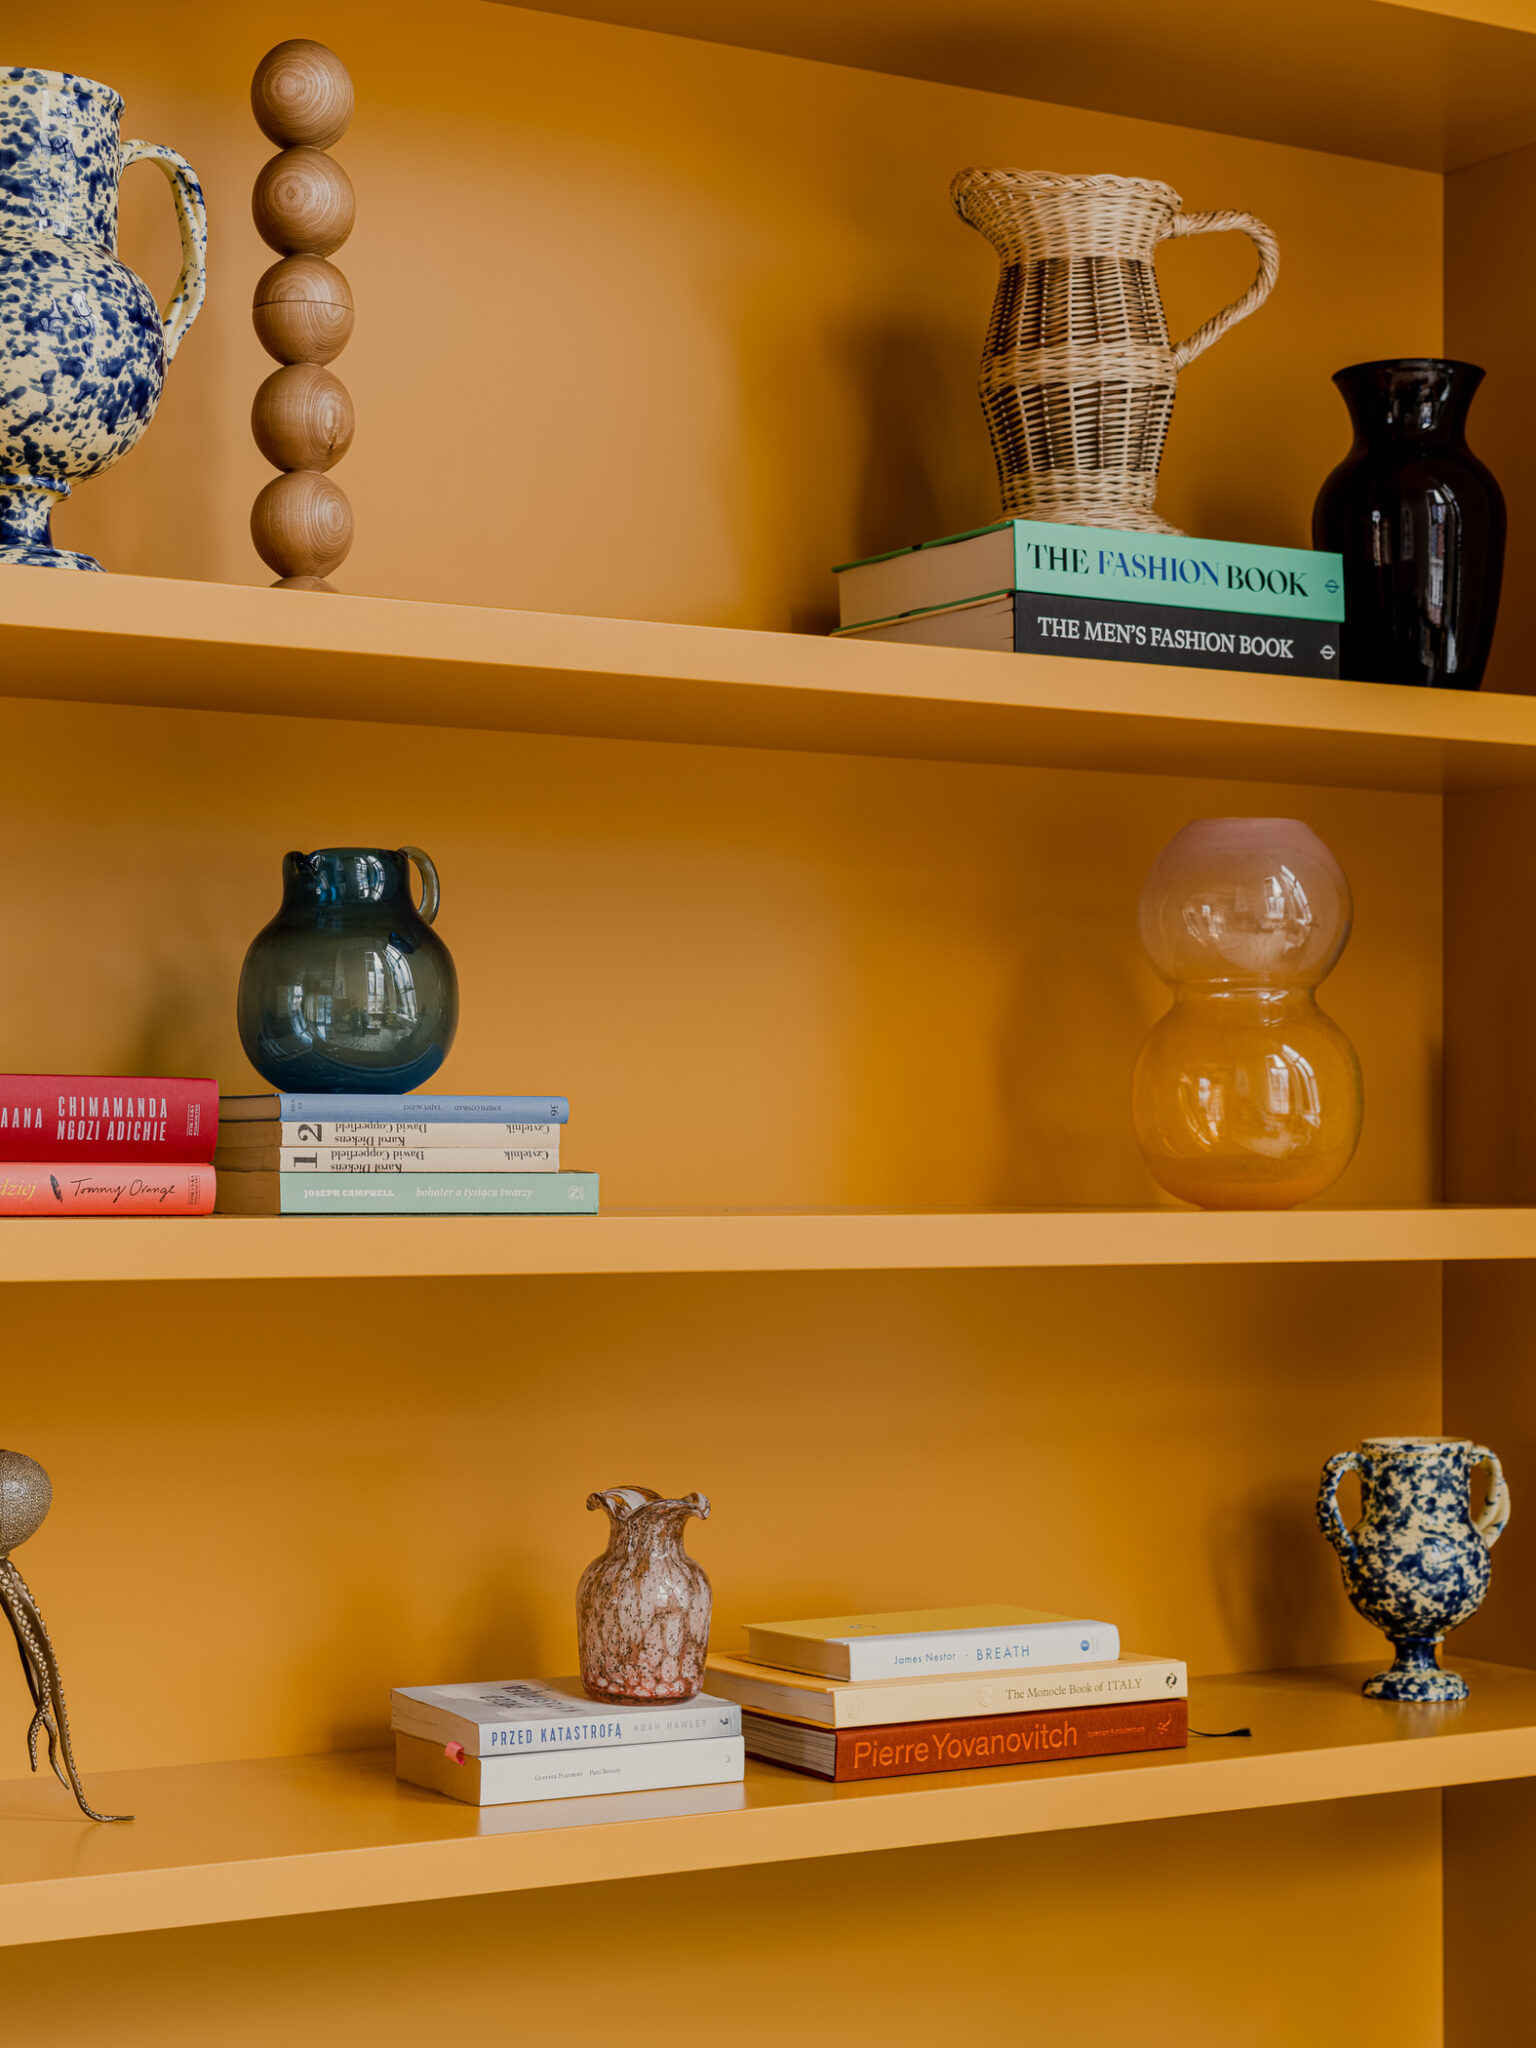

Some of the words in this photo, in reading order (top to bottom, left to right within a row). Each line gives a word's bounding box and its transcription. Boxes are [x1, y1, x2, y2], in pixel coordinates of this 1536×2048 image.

[1026, 542, 1090, 574] THE
[1098, 549, 1220, 587] FASHION
[1227, 564, 1309, 597] BOOK
[1037, 616, 1080, 639] THE
[1084, 620, 1147, 646] MEN’S
[1150, 626, 1235, 654] FASHION
[1239, 635, 1295, 659] BOOK
[58, 1096, 168, 1118] CHIMAMANDA
[550, 1104, 559, 1116] 36
[0, 1107, 43, 1128] AANA
[57, 1120, 100, 1141] NGOZI
[107, 1121, 167, 1142] ADICHIE
[297, 1122, 323, 1143] 2
[396, 1123, 427, 1133] Dawid
[334, 1136, 375, 1146] Dickens
[377, 1136, 405, 1146] Karol
[293, 1153, 319, 1168] 1
[331, 1147, 390, 1161] Copperfield
[393, 1150, 425, 1160] Dawid
[504, 1148, 549, 1161] Czytelnik
[330, 1163, 371, 1173] Dickens
[374, 1163, 402, 1173] Karol
[70, 1177, 127, 1204] Tommy
[129, 1179, 176, 1204] Orange
[303, 1188, 341, 1199] JOSEPH
[342, 1188, 395, 1198] CAMPBELL
[415, 1186, 453, 1197] bohater
[456, 1189, 462, 1197] o
[500, 1187, 533, 1199] twarzy
[894, 1655, 922, 1665] James
[925, 1652, 956, 1662] Nestor
[976, 1644, 1030, 1661] BREATH
[1005, 1689, 1025, 1700] The
[1027, 1685, 1067, 1698] Monocle
[1069, 1683, 1093, 1694] Book
[1094, 1681, 1104, 1692] of
[1107, 1678, 1142, 1691] ITALY
[633, 1723, 660, 1733] NOAH
[666, 1719, 708, 1730] HAWLEY
[491, 1729, 533, 1747] PRZED
[540, 1722, 622, 1743] KATASTROFĄ
[854, 1741, 930, 1769] Pierre
[932, 1720, 1078, 1760] Yovanovitch
